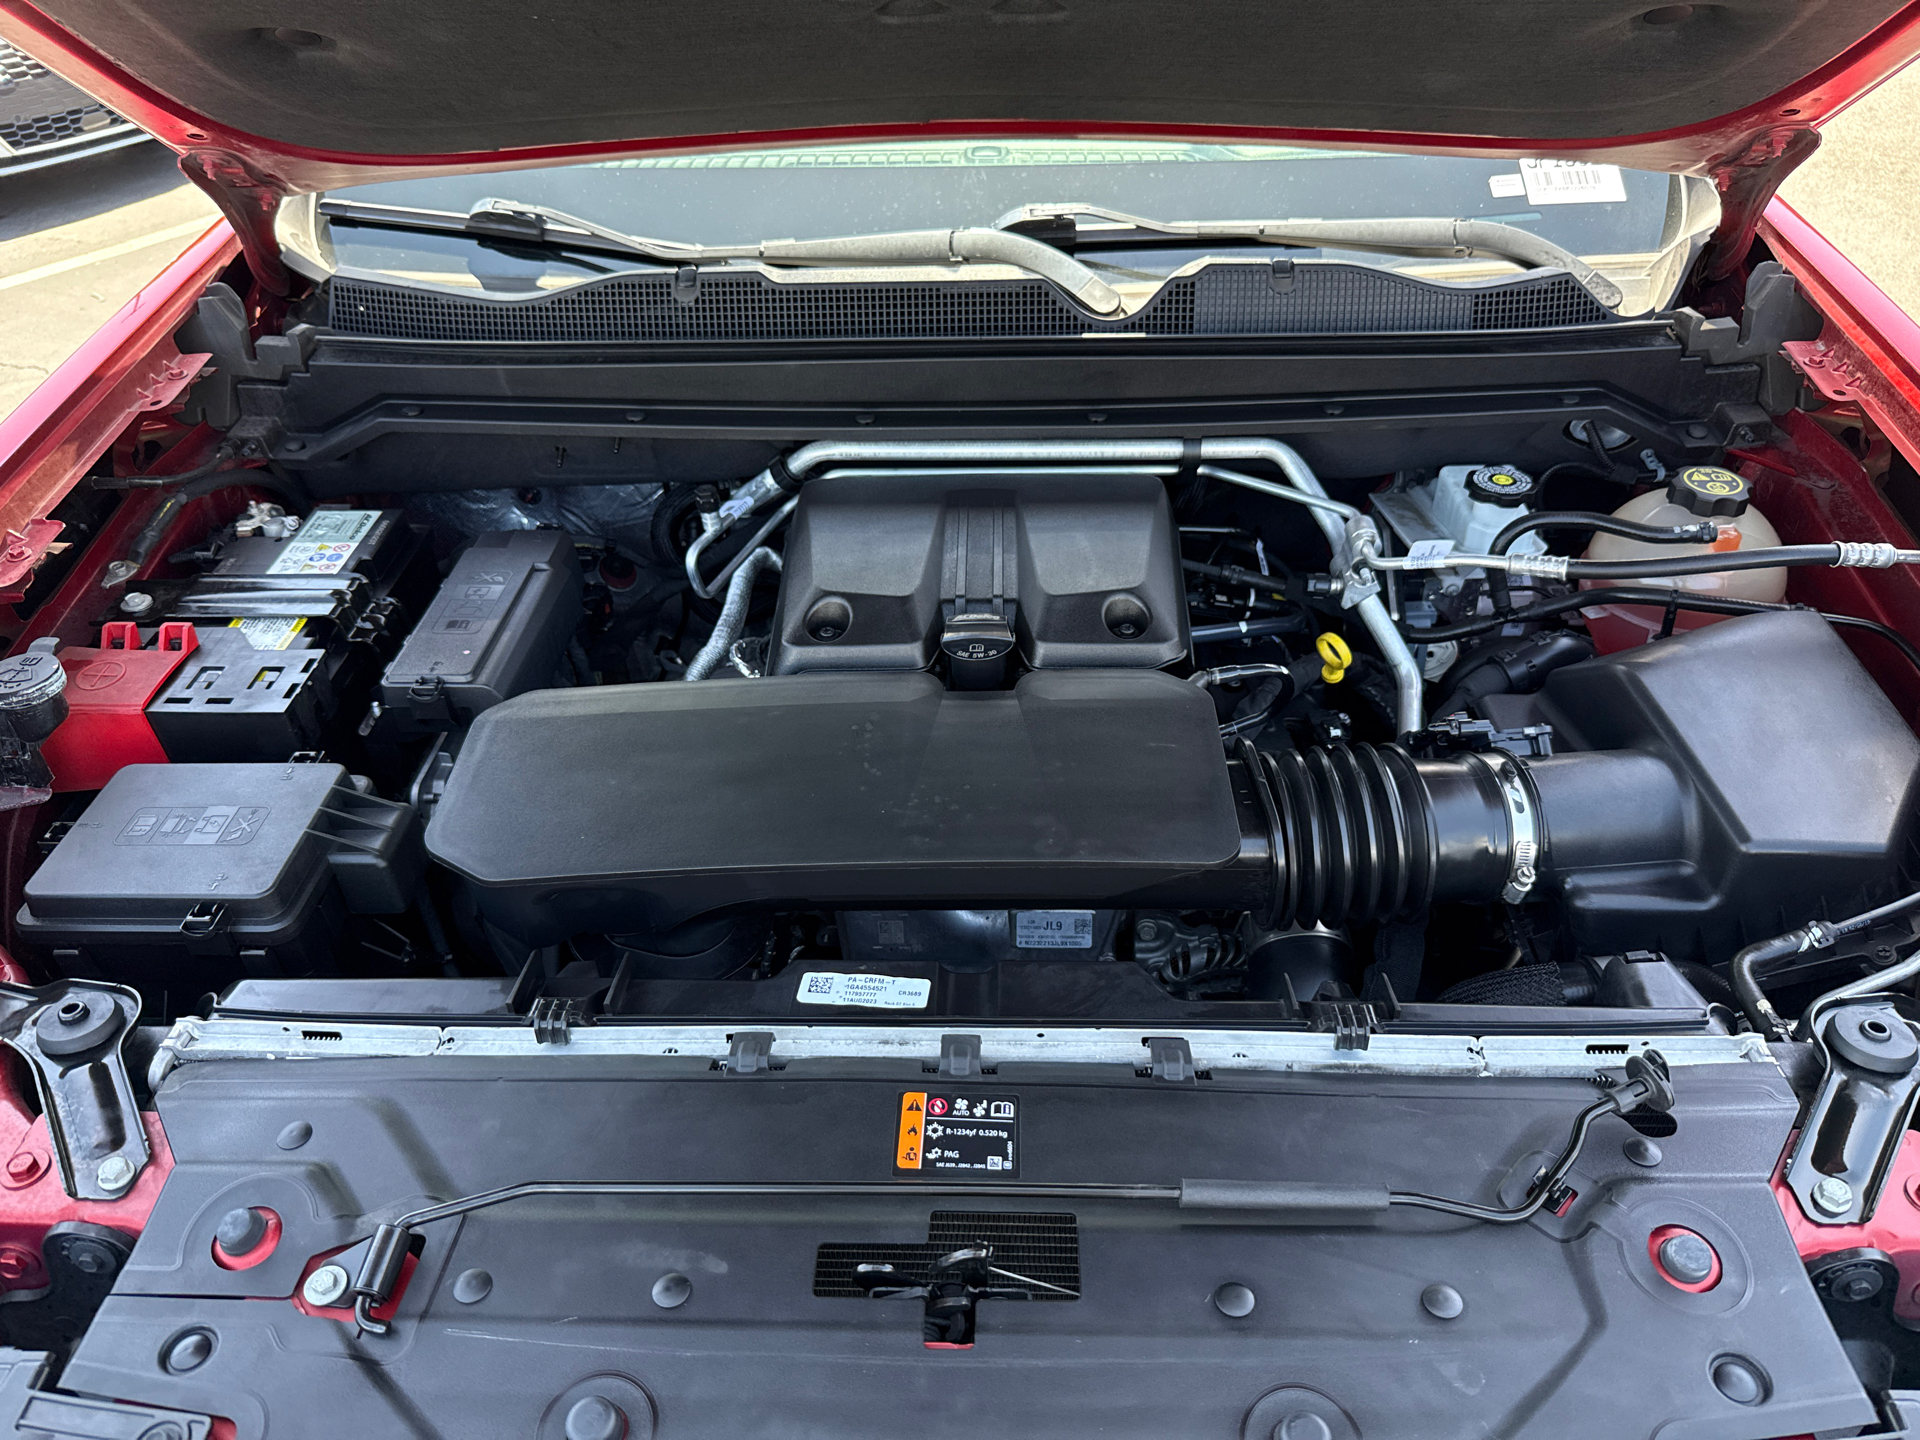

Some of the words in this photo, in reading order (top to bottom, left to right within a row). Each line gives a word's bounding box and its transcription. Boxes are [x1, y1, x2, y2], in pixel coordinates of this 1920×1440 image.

[973, 650, 997, 658] 5W-30
[1043, 920, 1063, 931] JL9
[946, 1128, 977, 1138] R-1234yf
[979, 1129, 998, 1137] 0.520
[999, 1130, 1008, 1138] kg
[944, 1151, 959, 1159] PAG
